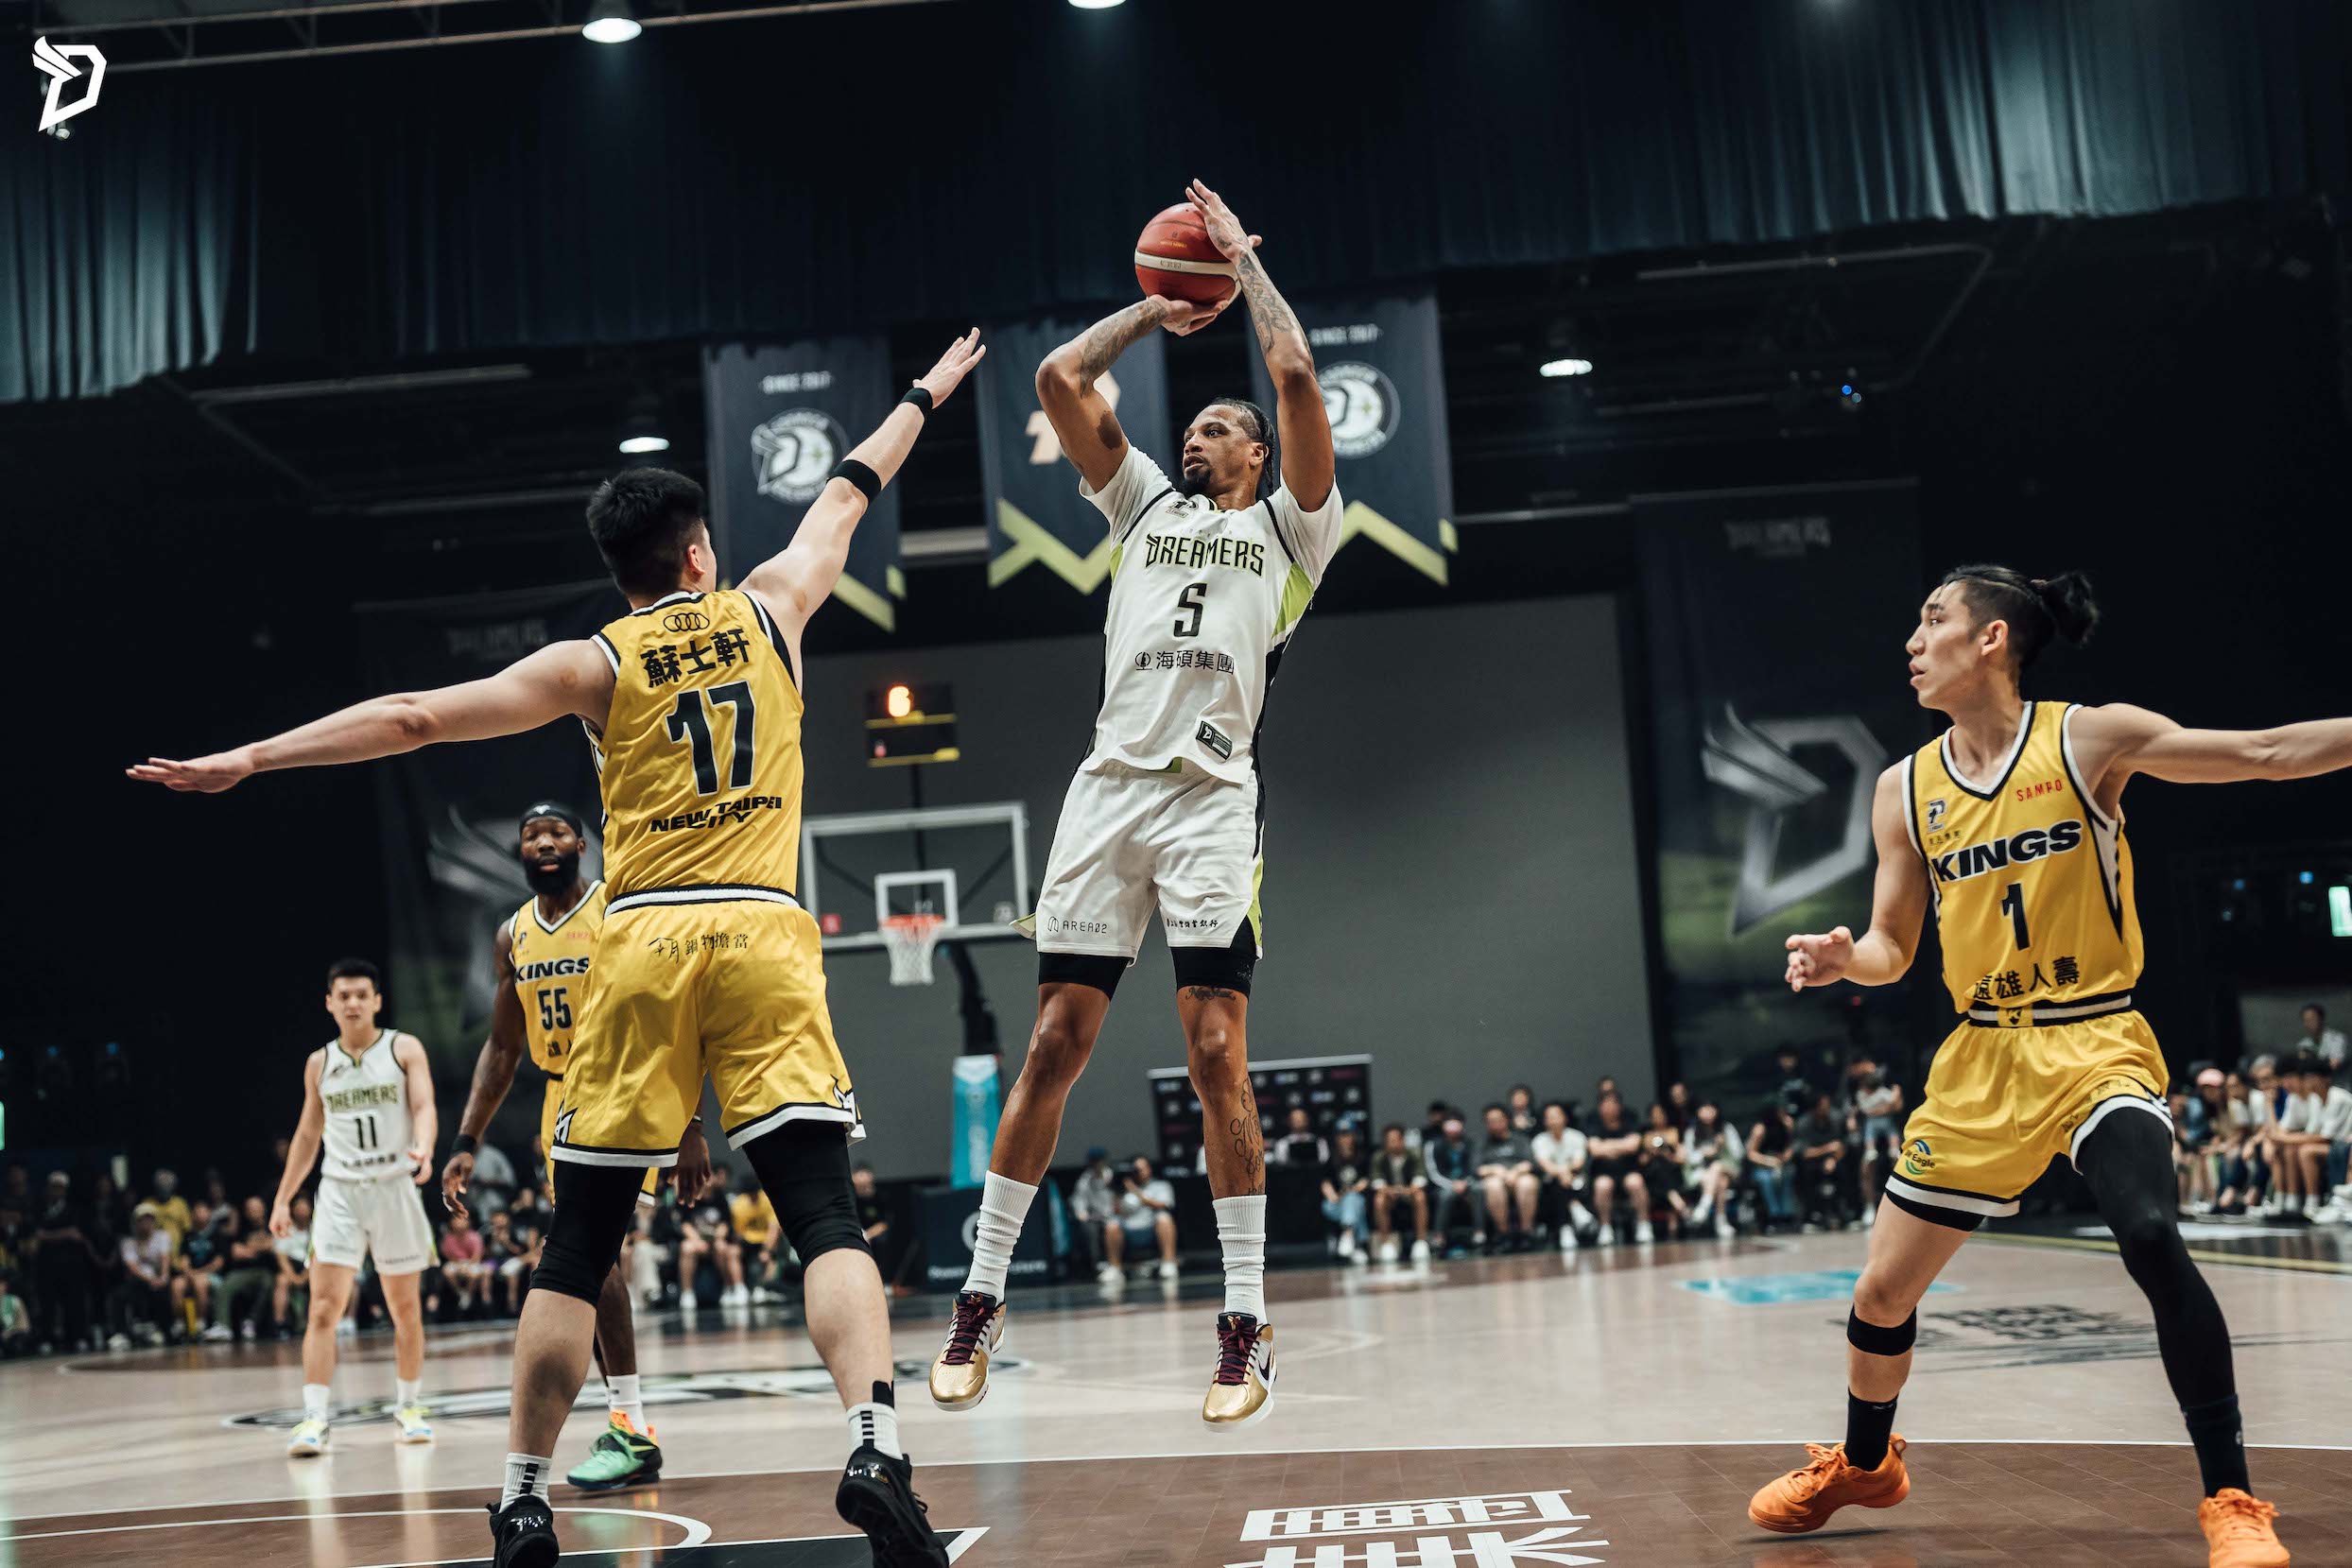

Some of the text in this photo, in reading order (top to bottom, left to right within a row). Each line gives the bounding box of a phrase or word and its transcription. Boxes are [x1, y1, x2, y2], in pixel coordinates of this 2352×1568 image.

[1145, 533, 1265, 577] DREAMERS
[1173, 582, 1207, 637] 5
[640, 628, 750, 688] 蘇士軒
[1156, 649, 1235, 675] 海碩集團
[665, 680, 755, 798] 17
[2016, 779, 2063, 801] SAMPO
[650, 797, 782, 832] NEW TAIPEI
[1930, 818, 2083, 883] KINGS
[1063, 920, 1108, 934] AREA02
[2000, 882, 2031, 951] 1
[514, 956, 590, 982] KINGS
[1973, 956, 2080, 1000] 遠雄人壽
[537, 988, 573, 1031] 55
[355, 1115, 377, 1149] 11
[1911, 1153, 1936, 1169] Eagle
